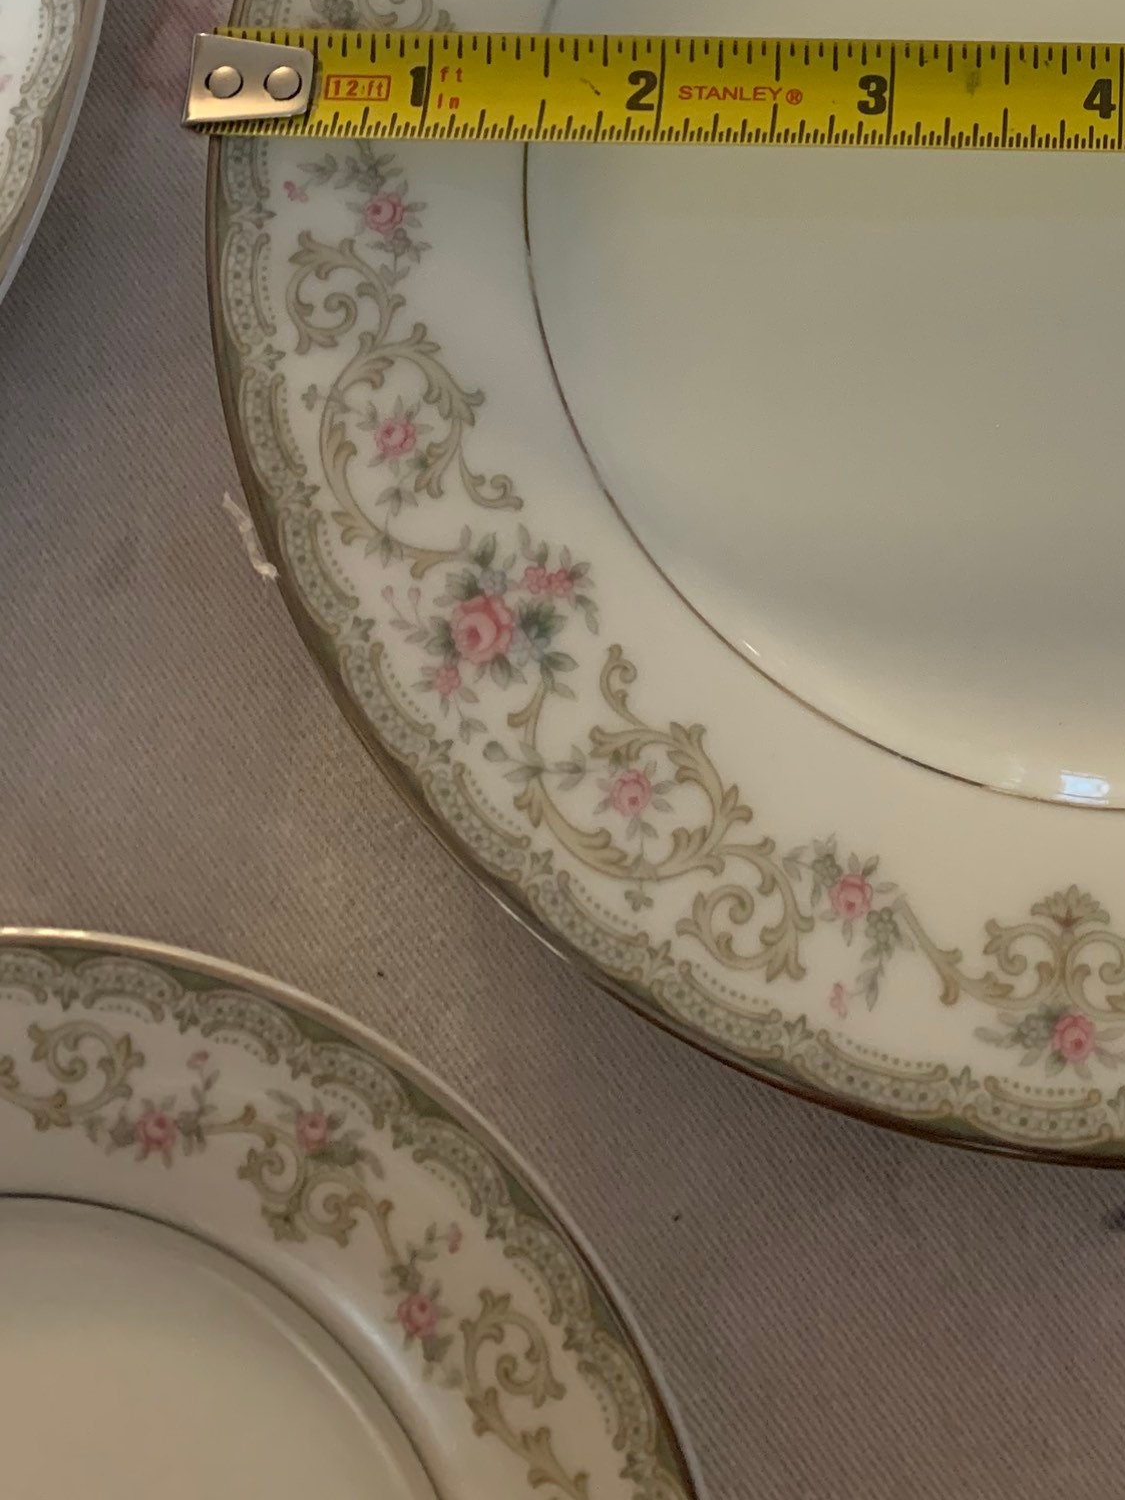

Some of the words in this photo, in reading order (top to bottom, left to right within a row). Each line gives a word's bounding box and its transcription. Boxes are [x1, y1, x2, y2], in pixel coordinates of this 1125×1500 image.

[332, 80, 359, 97] 12
[368, 80, 384, 97] ft
[410, 66, 427, 107] 1
[440, 66, 463, 83] ft
[626, 70, 658, 111] 2
[857, 74, 888, 115] 3
[1083, 78, 1117, 120] 4
